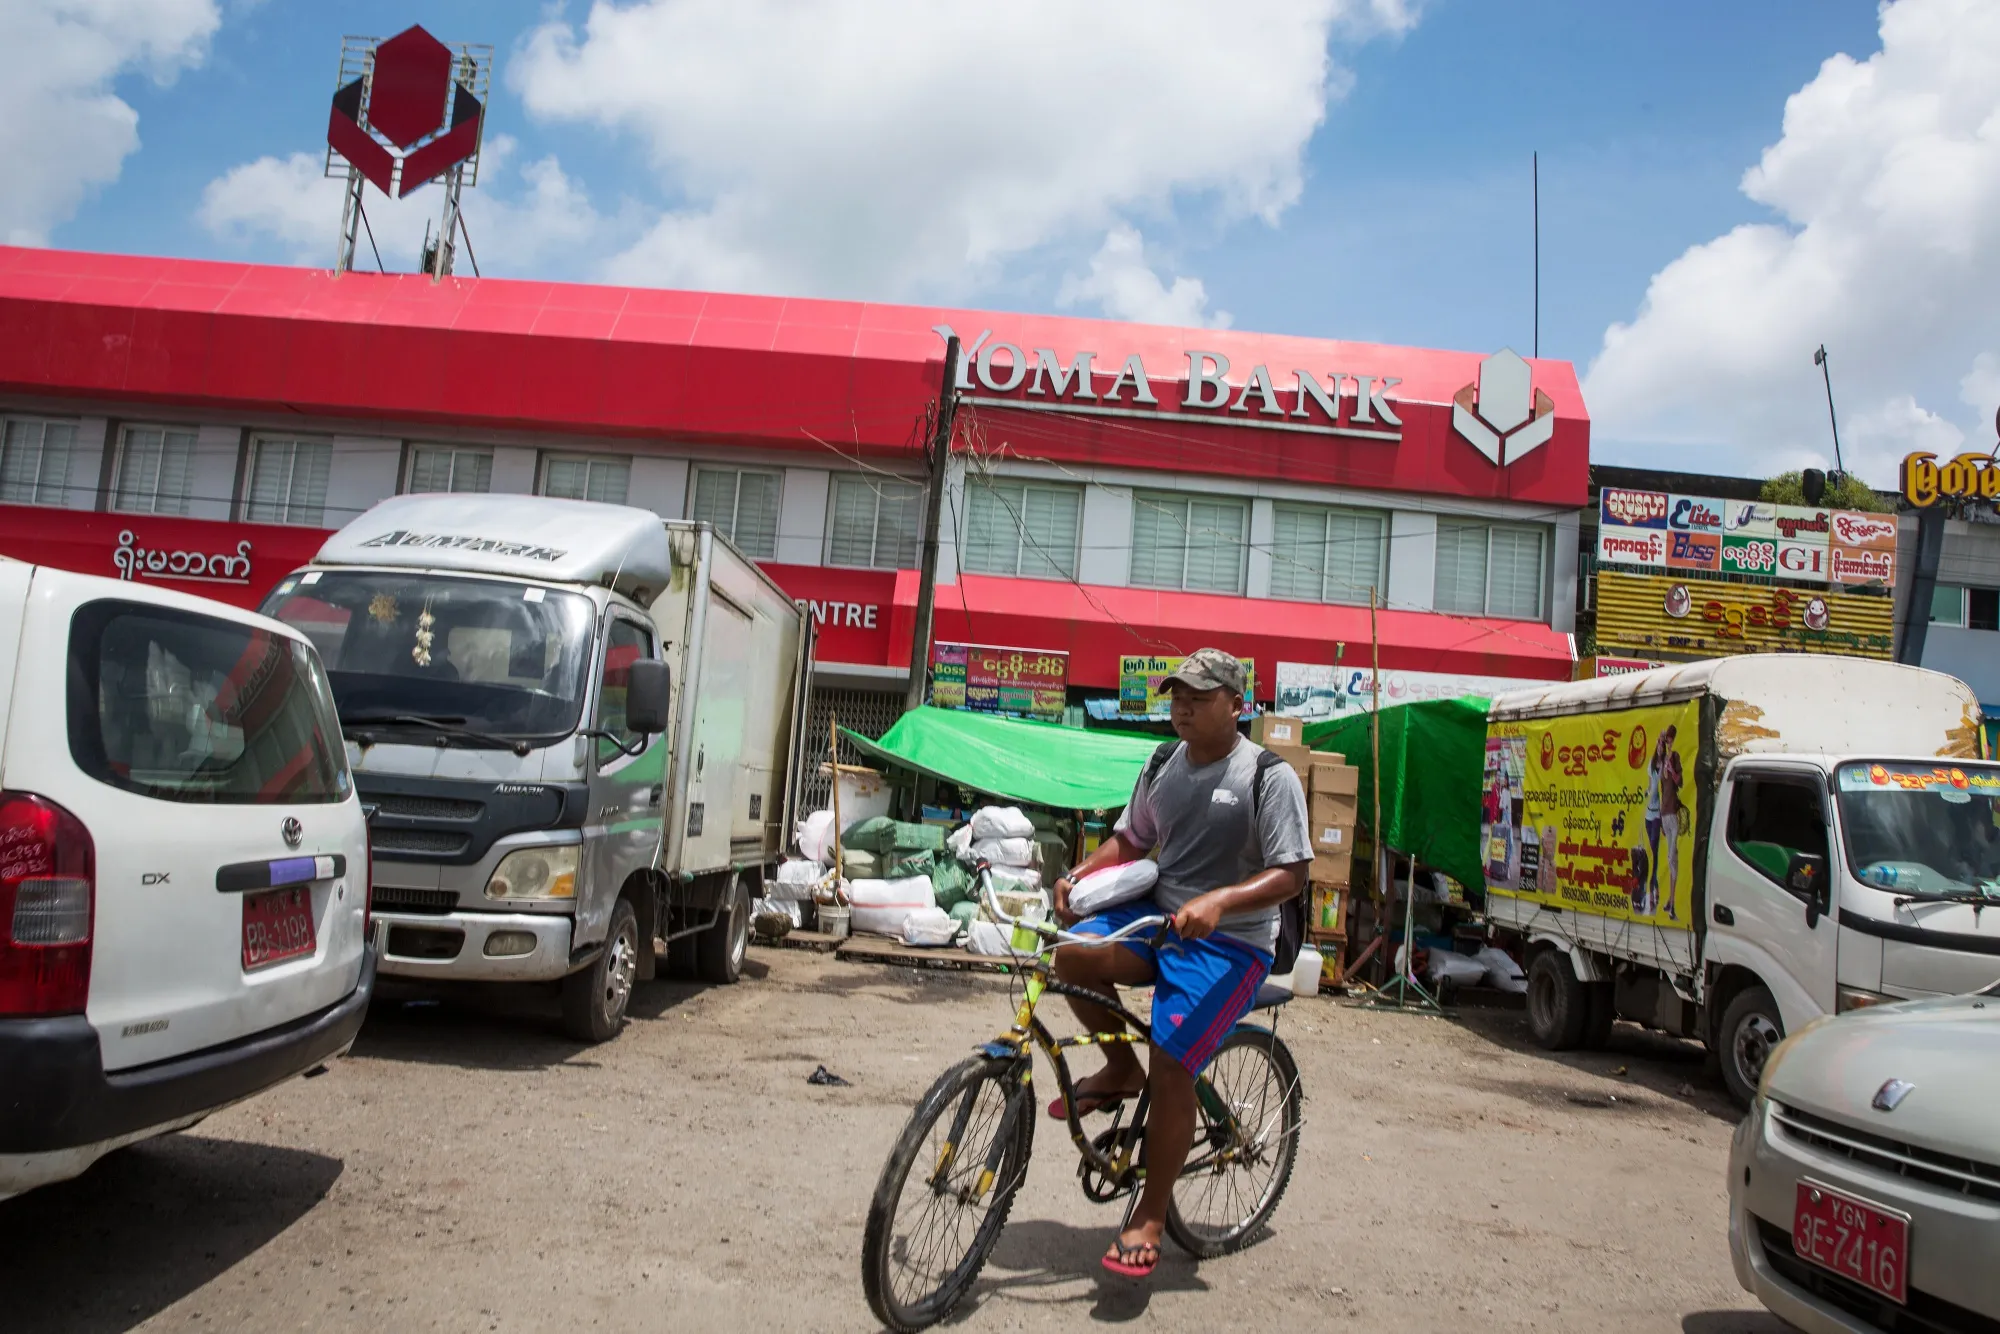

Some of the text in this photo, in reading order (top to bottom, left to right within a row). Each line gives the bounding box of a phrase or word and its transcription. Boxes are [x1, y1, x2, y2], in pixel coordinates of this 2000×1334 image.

[933, 324, 1402, 427] YOMA BANK
[1669, 499, 1722, 529] Elite
[1779, 547, 1823, 573] GI
[795, 598, 878, 629] NTRE
[142, 872, 171, 886] DX
[1831, 1199, 1867, 1230] YGN
[1798, 1211, 1898, 1291] 3E-7416
